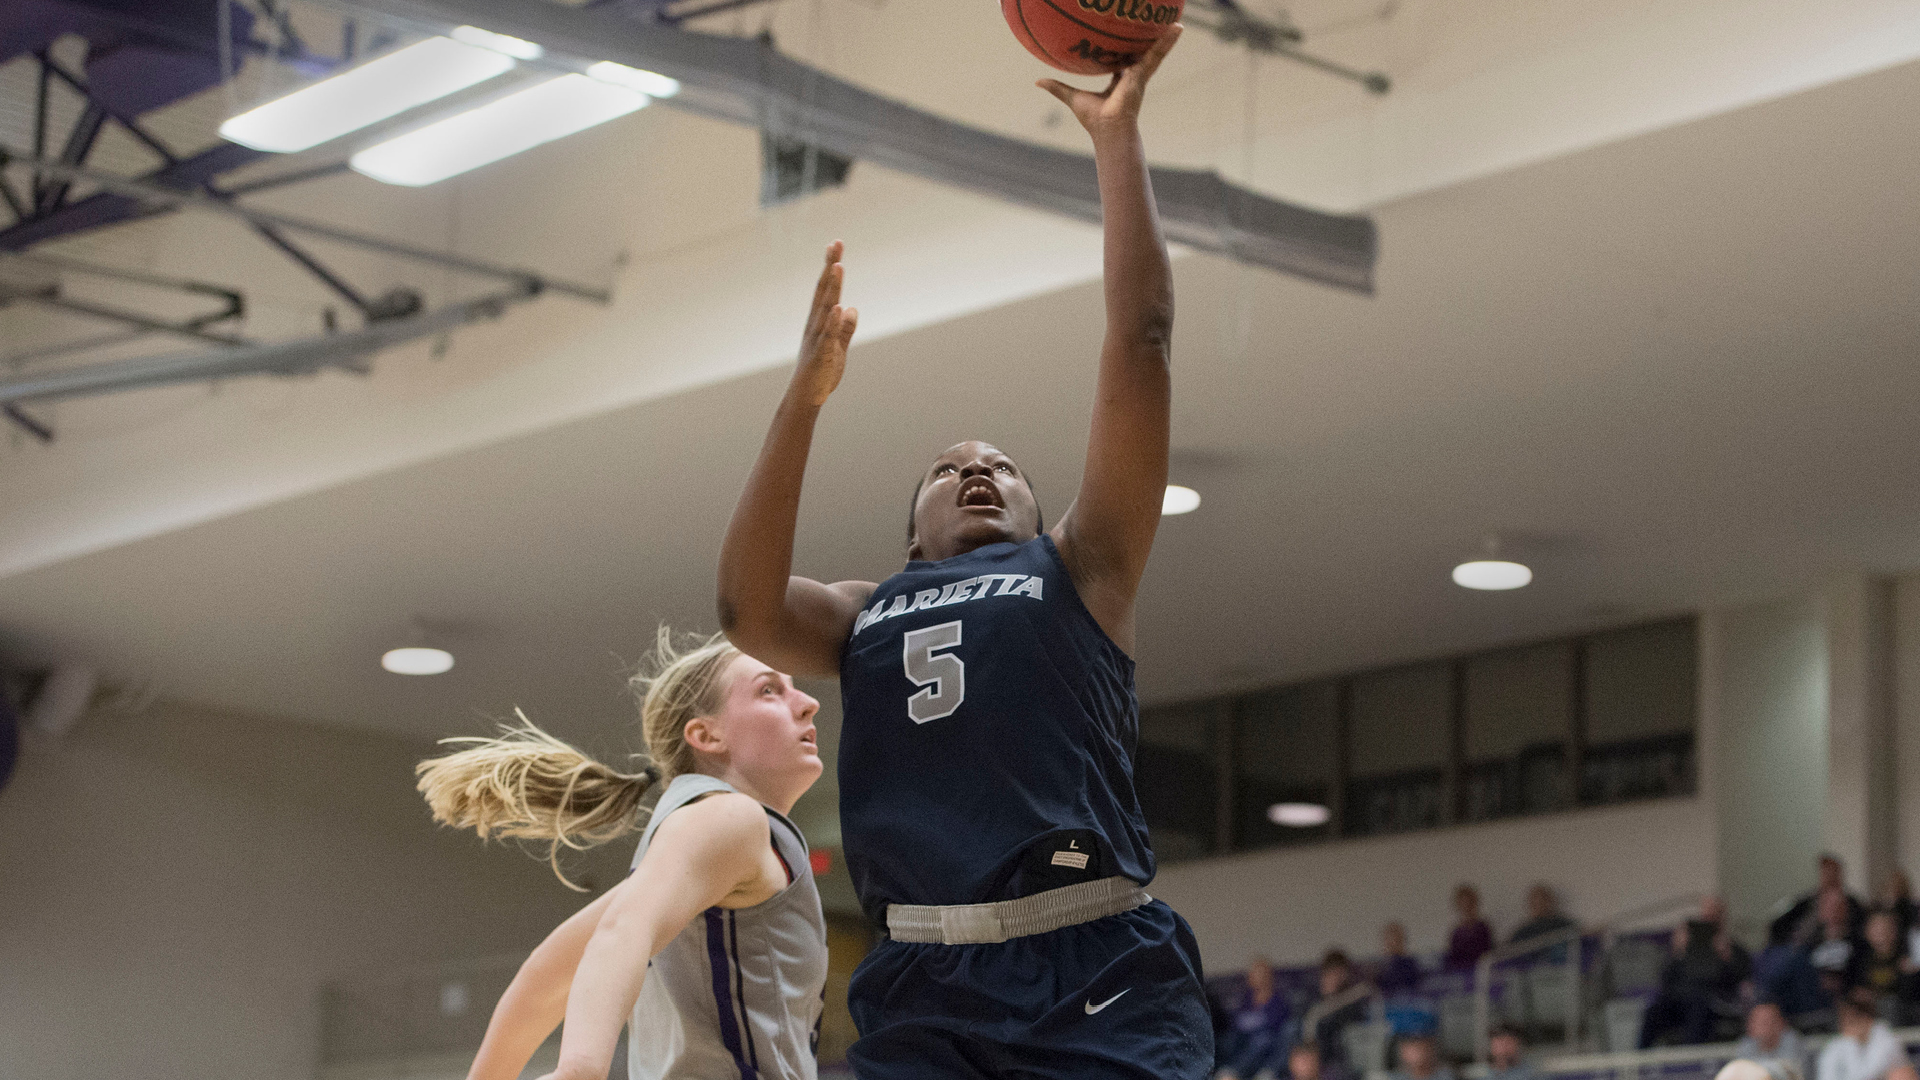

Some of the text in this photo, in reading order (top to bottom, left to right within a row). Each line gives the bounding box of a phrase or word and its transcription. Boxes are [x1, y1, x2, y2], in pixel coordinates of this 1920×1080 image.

[852, 574, 1043, 637] MARIETTA
[903, 620, 965, 725] 5
[1069, 839, 1079, 849] L
